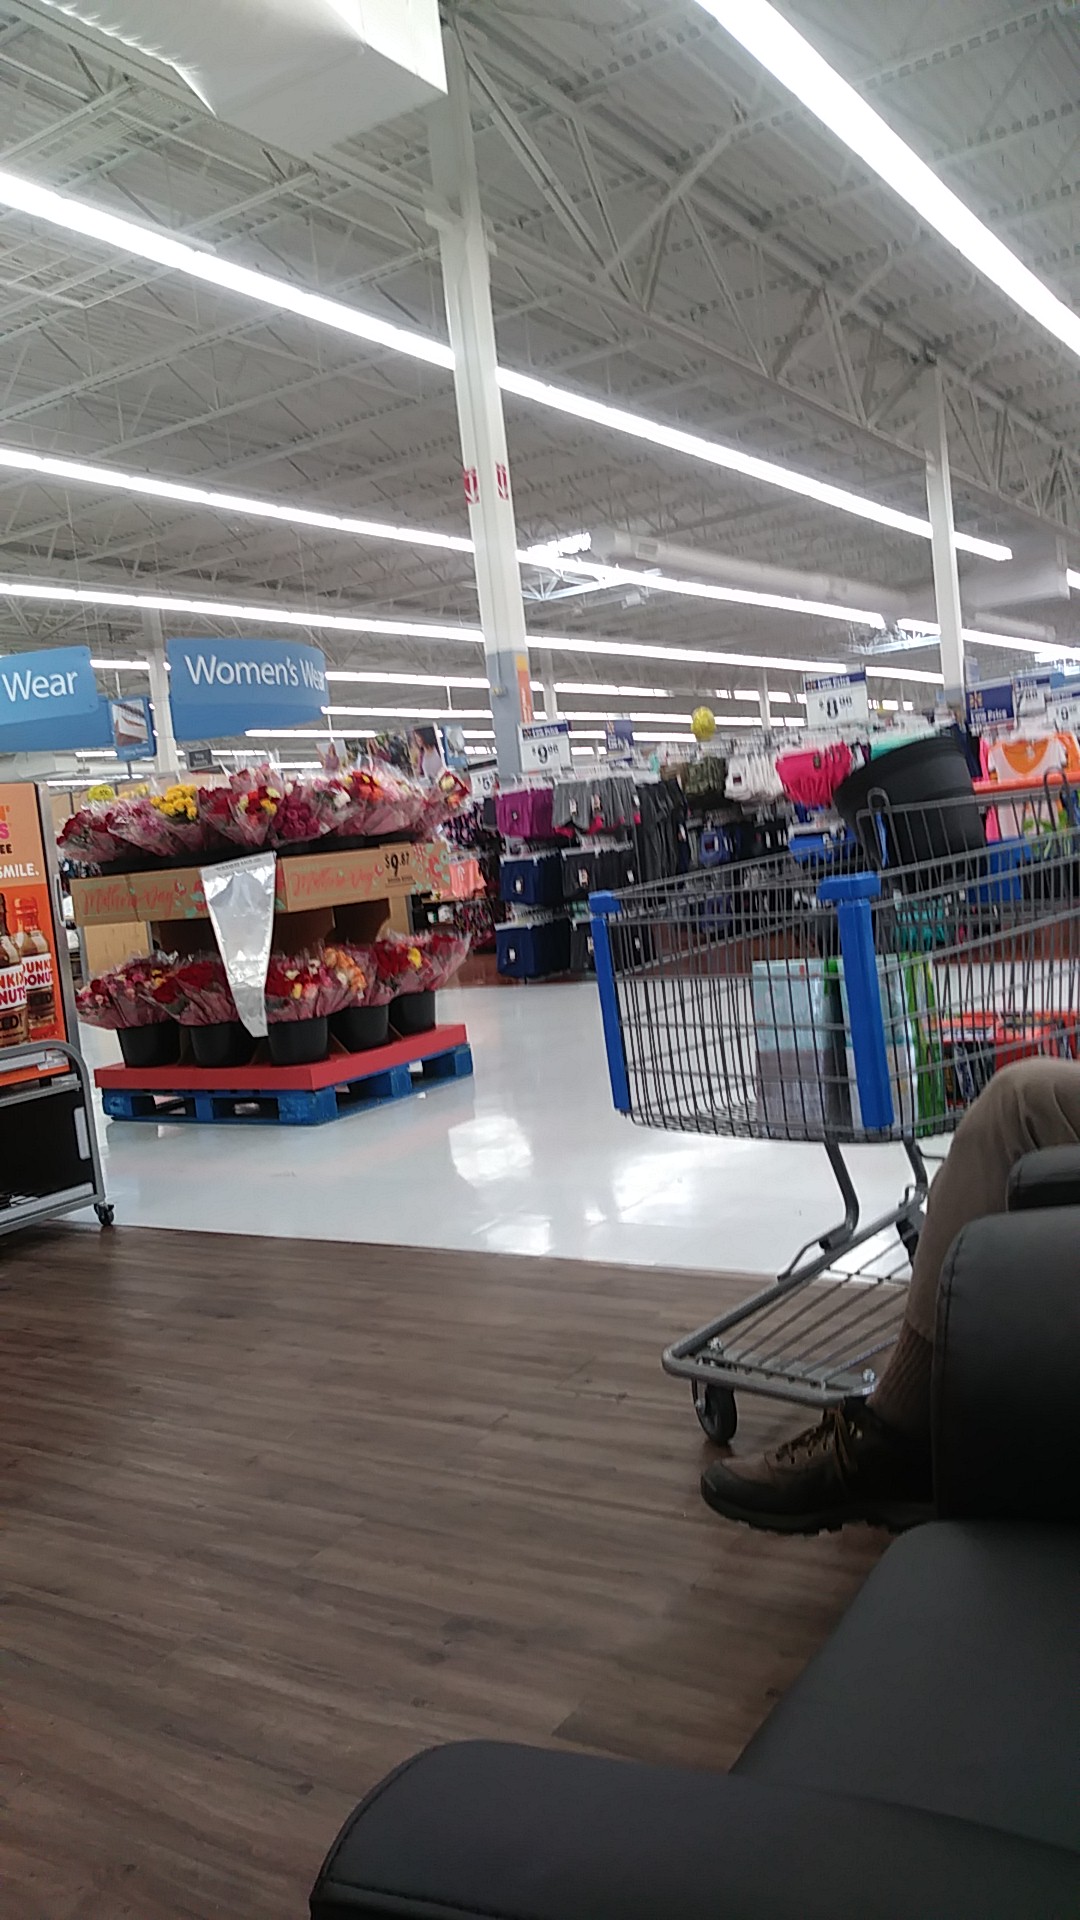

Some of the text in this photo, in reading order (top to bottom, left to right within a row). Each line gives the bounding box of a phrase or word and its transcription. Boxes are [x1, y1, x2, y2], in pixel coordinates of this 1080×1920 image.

[1, 669, 78, 703] Wear
[184, 654, 325, 692] Women's Wear
